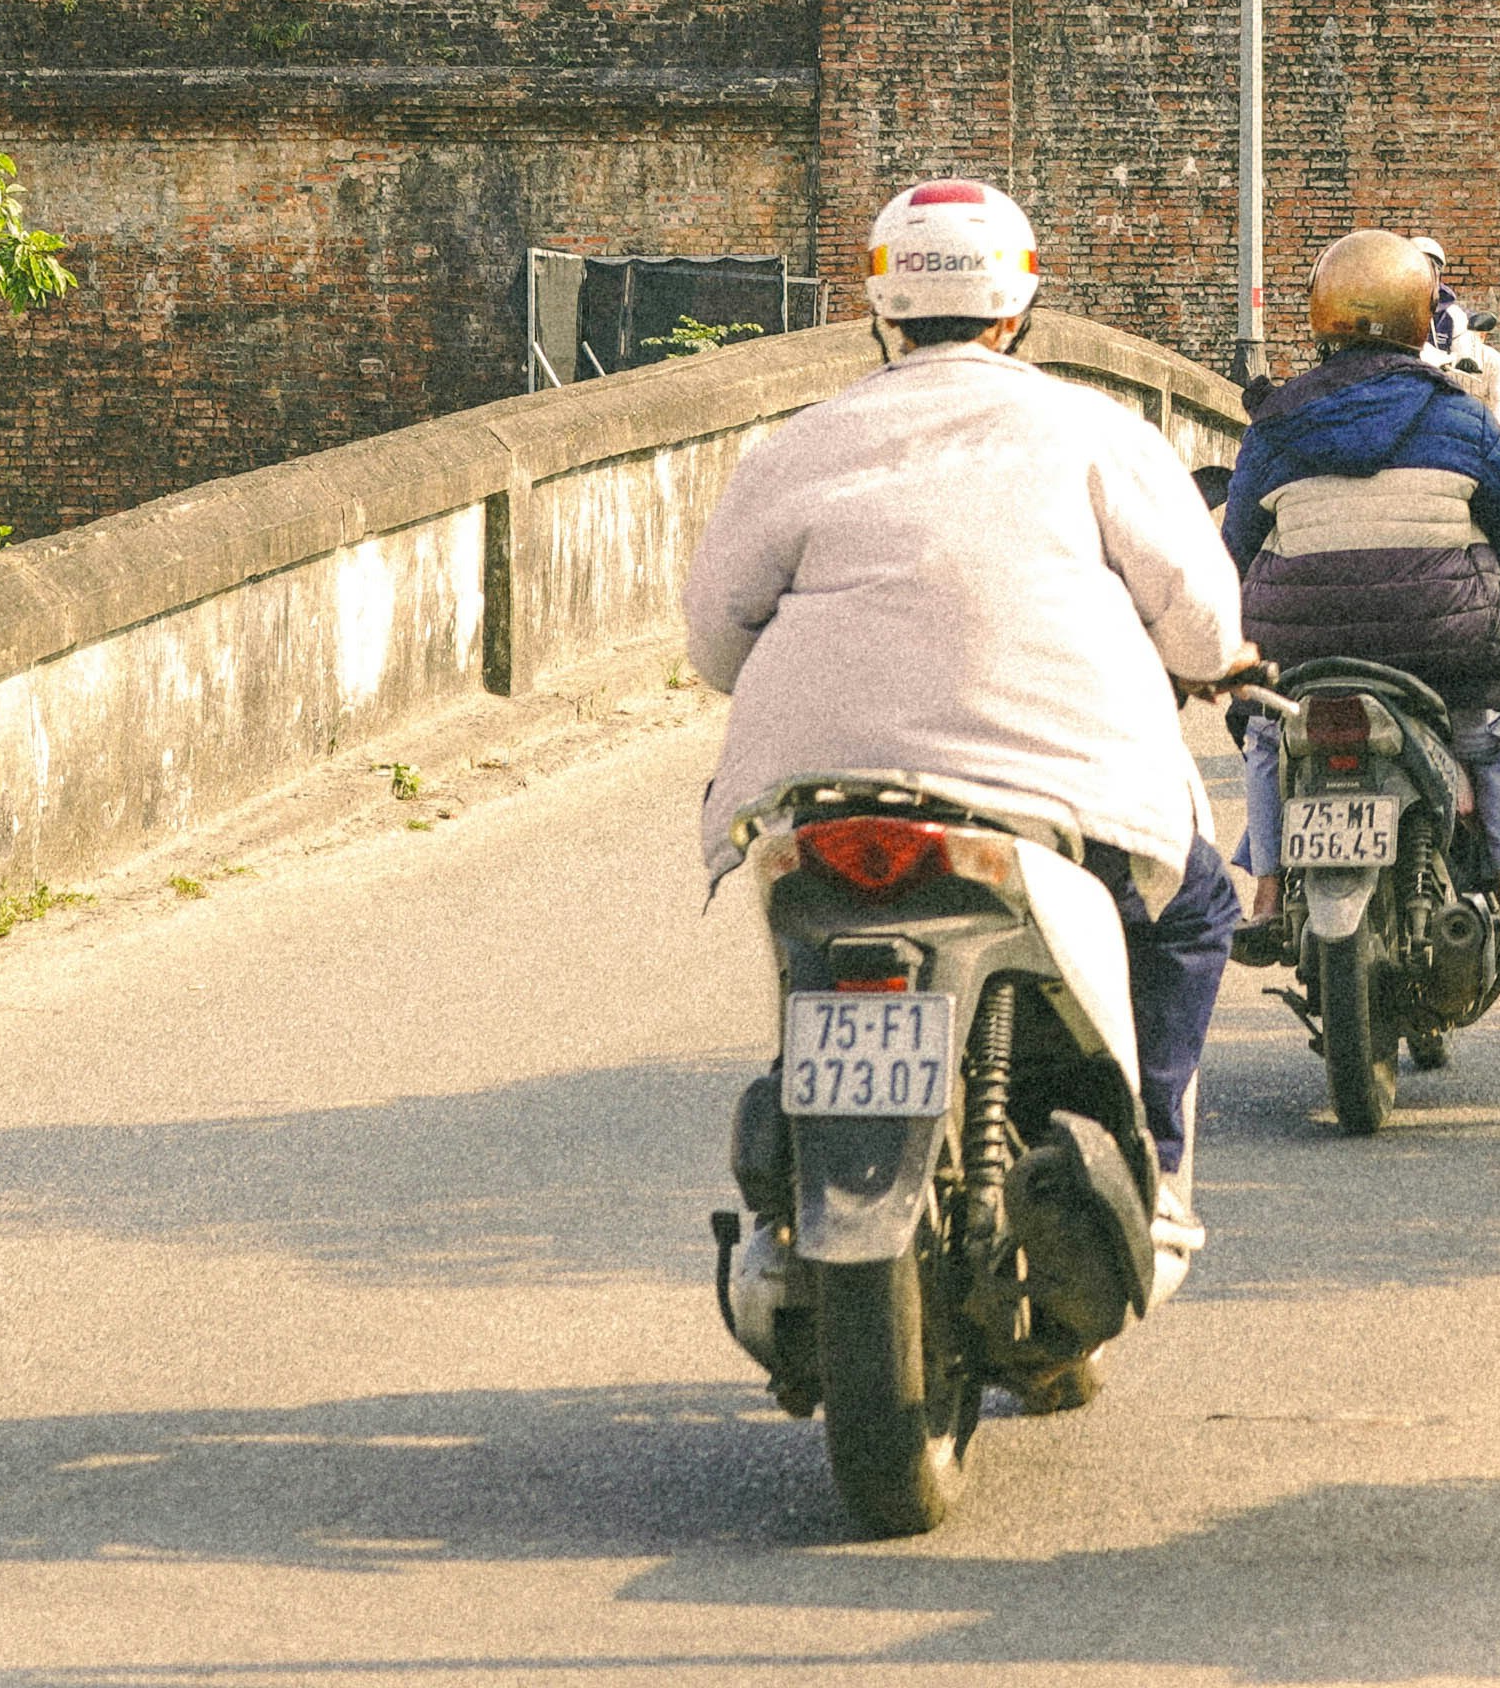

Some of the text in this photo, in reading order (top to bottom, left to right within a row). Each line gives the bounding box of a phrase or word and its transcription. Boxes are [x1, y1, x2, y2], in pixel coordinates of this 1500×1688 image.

[895, 252, 985, 272] HDBank
[1302, 801, 1376, 829] 75-M1
[1289, 832, 1388, 861] 056.45
[816, 1004, 922, 1050] 75-F1
[797, 1060, 939, 1107] 373.07
